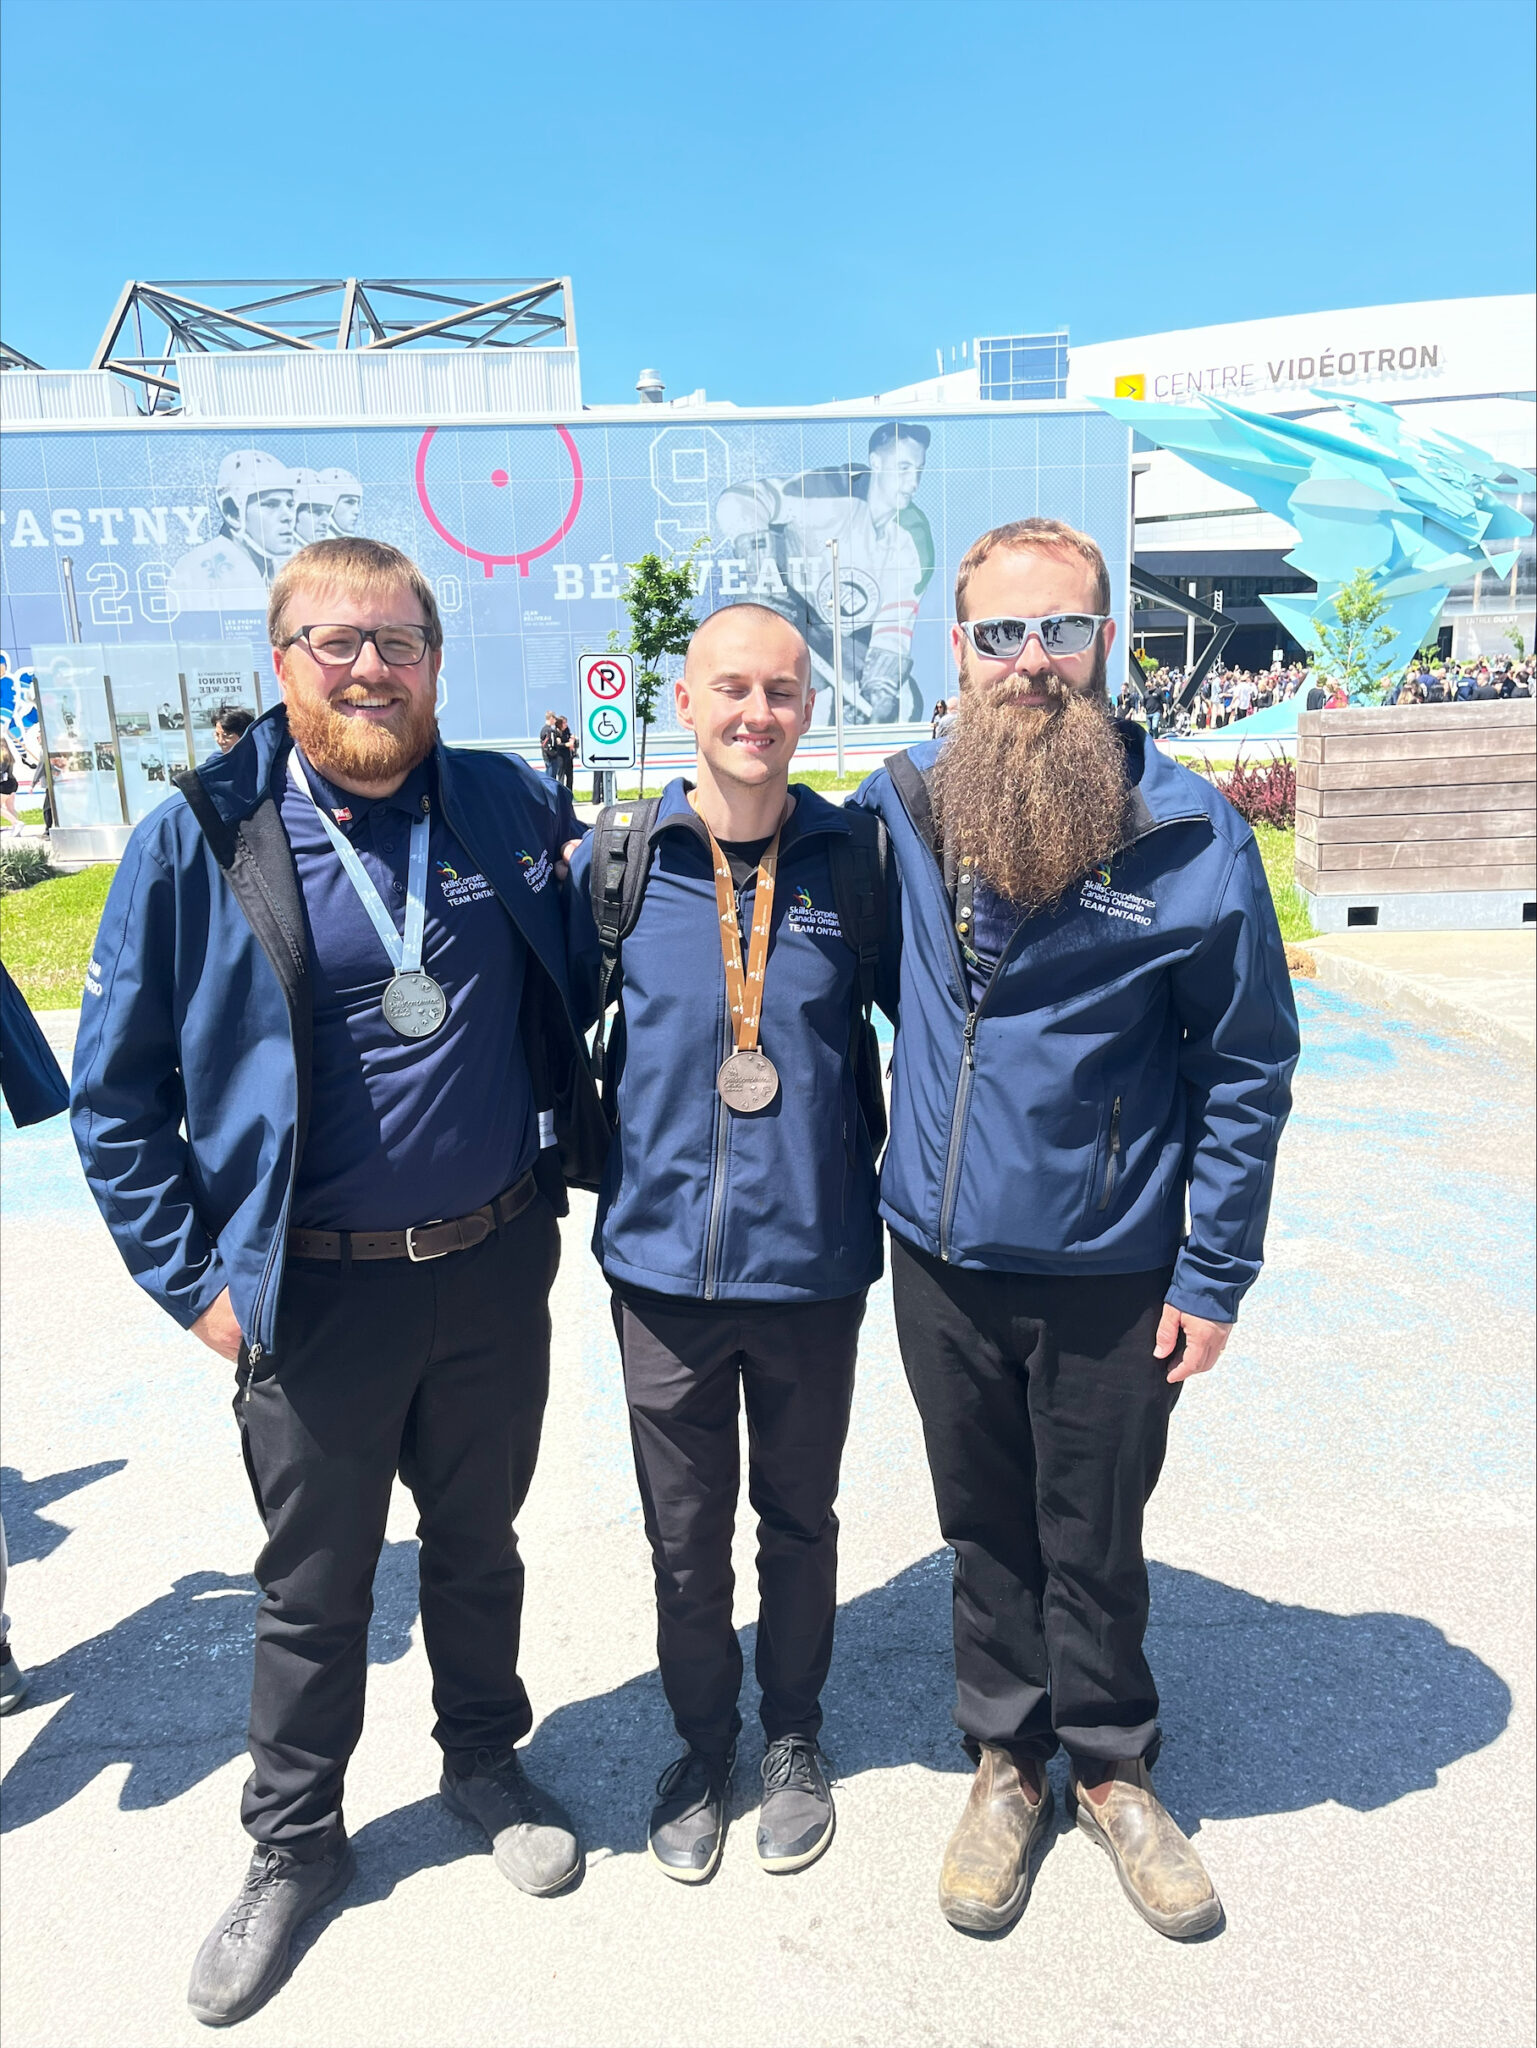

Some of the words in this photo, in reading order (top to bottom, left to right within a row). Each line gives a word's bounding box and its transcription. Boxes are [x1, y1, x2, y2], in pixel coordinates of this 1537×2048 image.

[1154, 363, 1254, 398] CENTRE
[1267, 344, 1438, 384] VIDÉOTRON
[649, 426, 731, 554] 9
[0, 506, 210, 548] ASTNY
[552, 553, 823, 601] BÉVEAU
[86, 561, 182, 625] 26
[600, 668, 616, 692] P
[443, 884, 469, 898] Canada
[447, 894, 472, 907] TEAM
[1081, 887, 1110, 904] Canada
[1111, 896, 1145, 913] Ontario
[788, 913, 816, 924] Canada
[1079, 897, 1107, 914] TEAM
[1106, 906, 1152, 926] ONTARIO
[788, 922, 815, 934] TEAM
[815, 926, 844, 938] ONTAR
